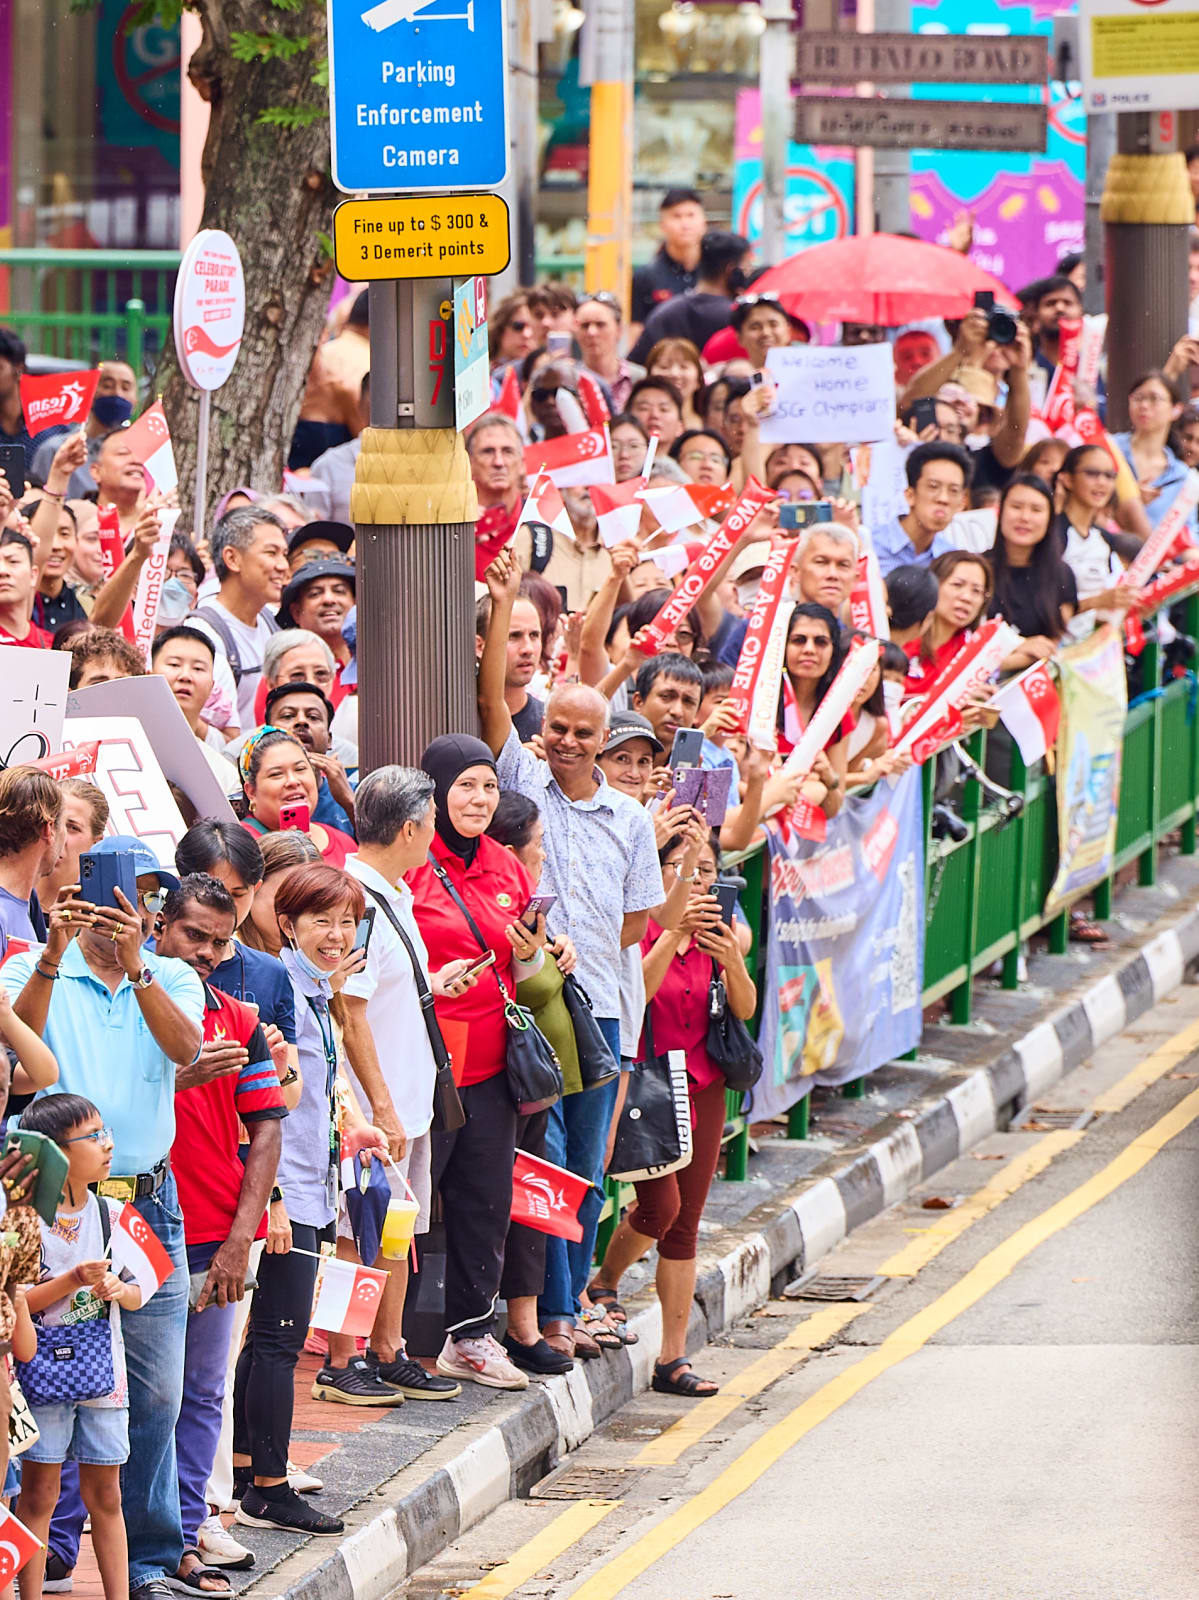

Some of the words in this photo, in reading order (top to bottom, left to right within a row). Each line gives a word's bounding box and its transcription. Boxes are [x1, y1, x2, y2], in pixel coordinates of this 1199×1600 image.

[382, 60, 456, 87] Parking
[356, 100, 484, 126] Enforcement
[382, 145, 460, 168] Camera
[354, 219, 383, 234] Fine
[388, 220, 405, 236] up
[410, 216, 425, 231] to
[430, 214, 442, 232] $
[447, 213, 474, 230] 300
[479, 213, 489, 228] &
[361, 246, 369, 260] 3
[374, 242, 433, 260] Demerit
[439, 240, 485, 261] points
[428, 364, 445, 407] 7
[727, 498, 762, 531] We
[699, 530, 733, 571] Are
[762, 547, 788, 583] We
[662, 575, 704, 625] ONE
[749, 591, 775, 631] Are
[732, 636, 761, 691] ONE
